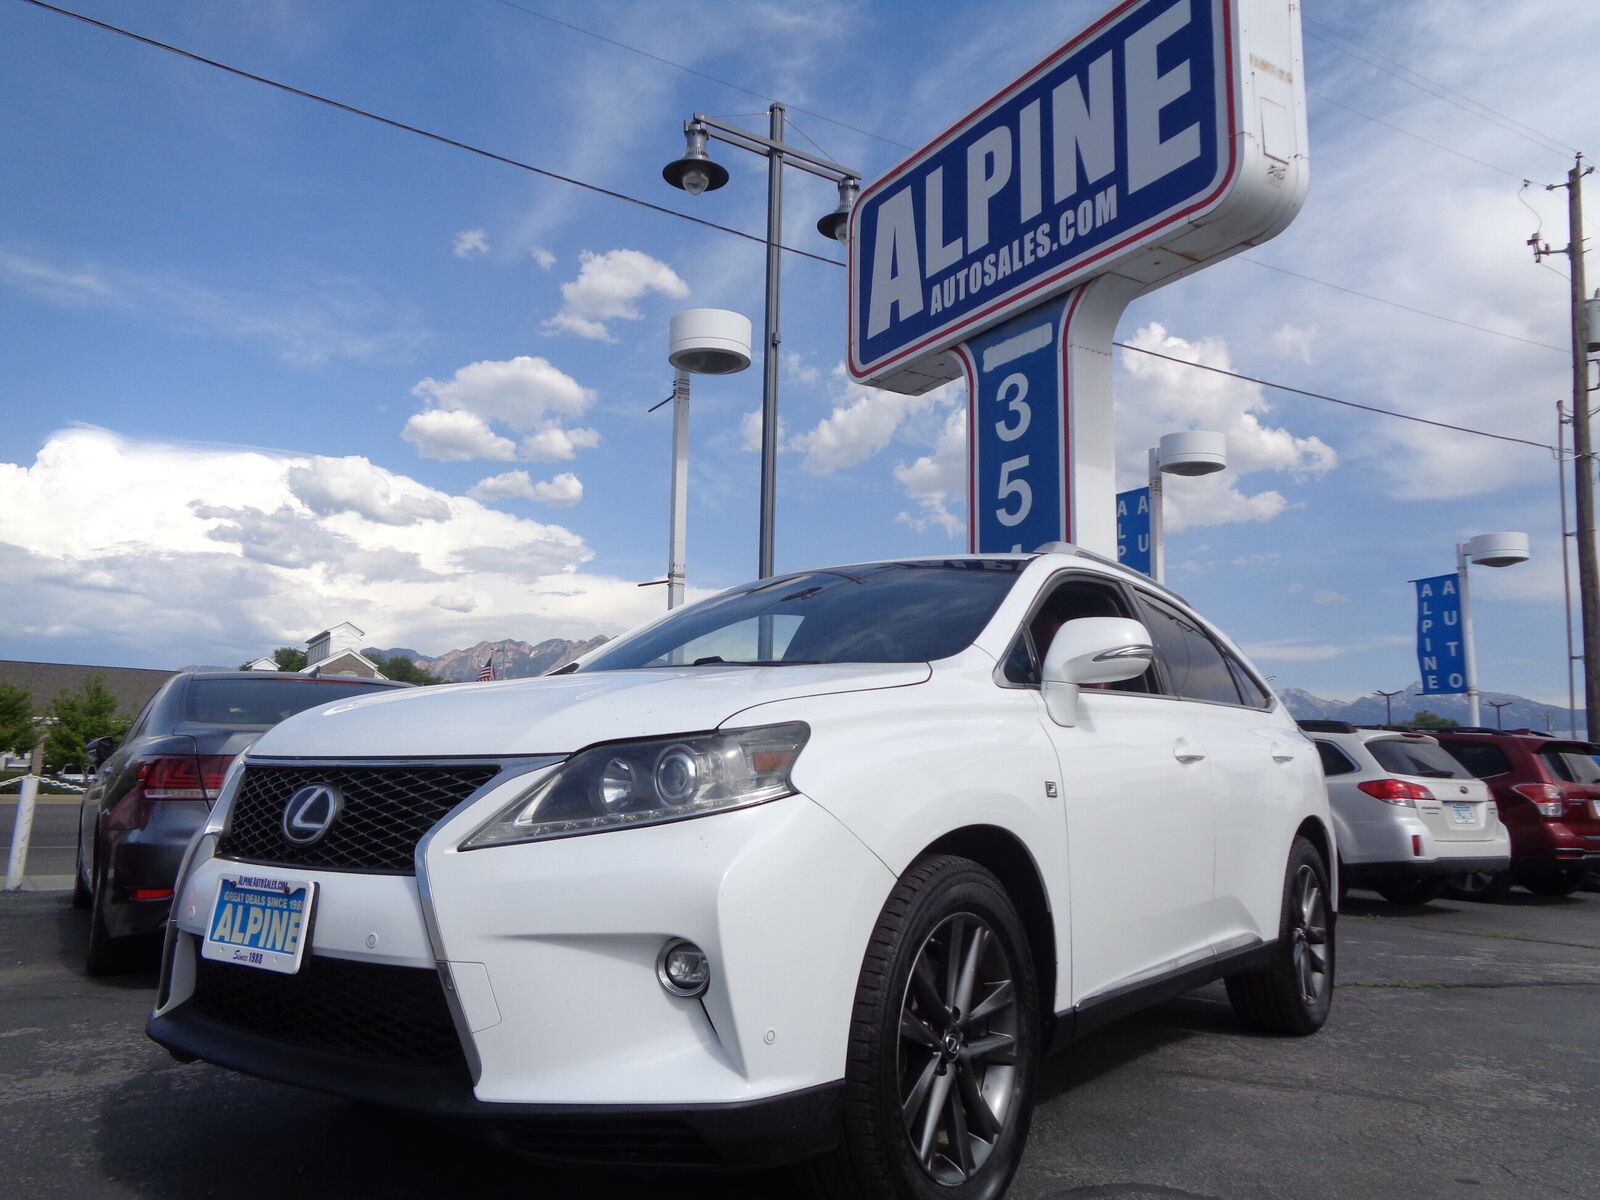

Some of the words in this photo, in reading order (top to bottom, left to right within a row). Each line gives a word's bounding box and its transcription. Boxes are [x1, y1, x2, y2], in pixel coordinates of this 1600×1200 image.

[867, 0, 1202, 340] ALPINE
[930, 185, 1118, 316] AUTOSALES.COM
[994, 372, 1033, 553] 35
[1421, 583, 1439, 689] ALPINE
[1442, 580, 1463, 688] AUTO
[213, 903, 302, 952] ALPINE
[224, 891, 244, 903] GREAT
[245, 894, 266, 906] DEALS
[267, 897, 288, 909] SINCE
